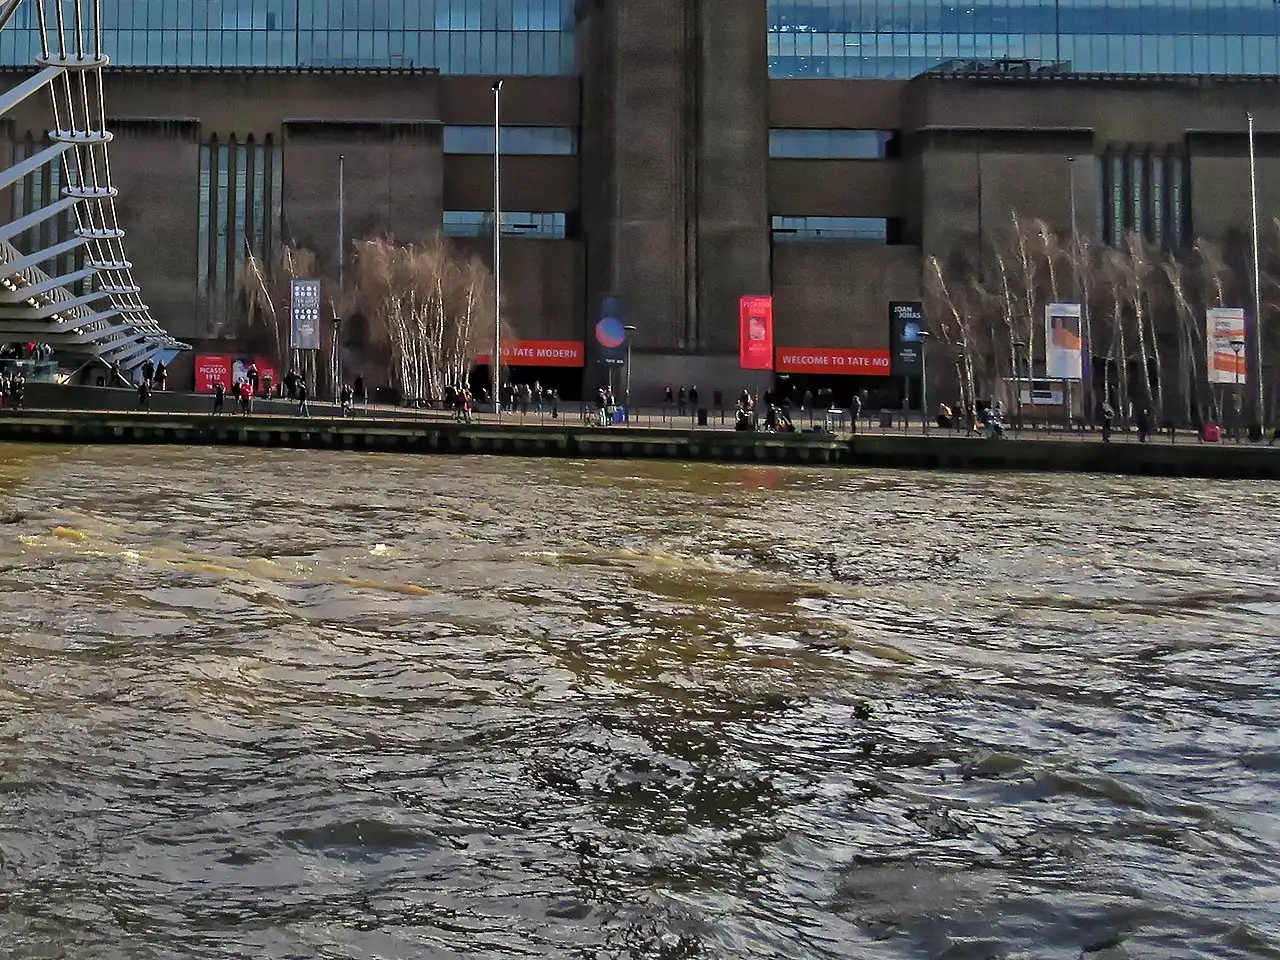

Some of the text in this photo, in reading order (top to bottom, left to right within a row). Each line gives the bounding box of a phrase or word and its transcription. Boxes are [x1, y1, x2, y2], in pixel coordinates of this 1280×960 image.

[512, 348, 534, 357] TATE
[536, 349, 577, 358] MODERN
[782, 355, 829, 365] WELCOME
[831, 356, 844, 365] TO
[847, 357, 869, 366] TATE
